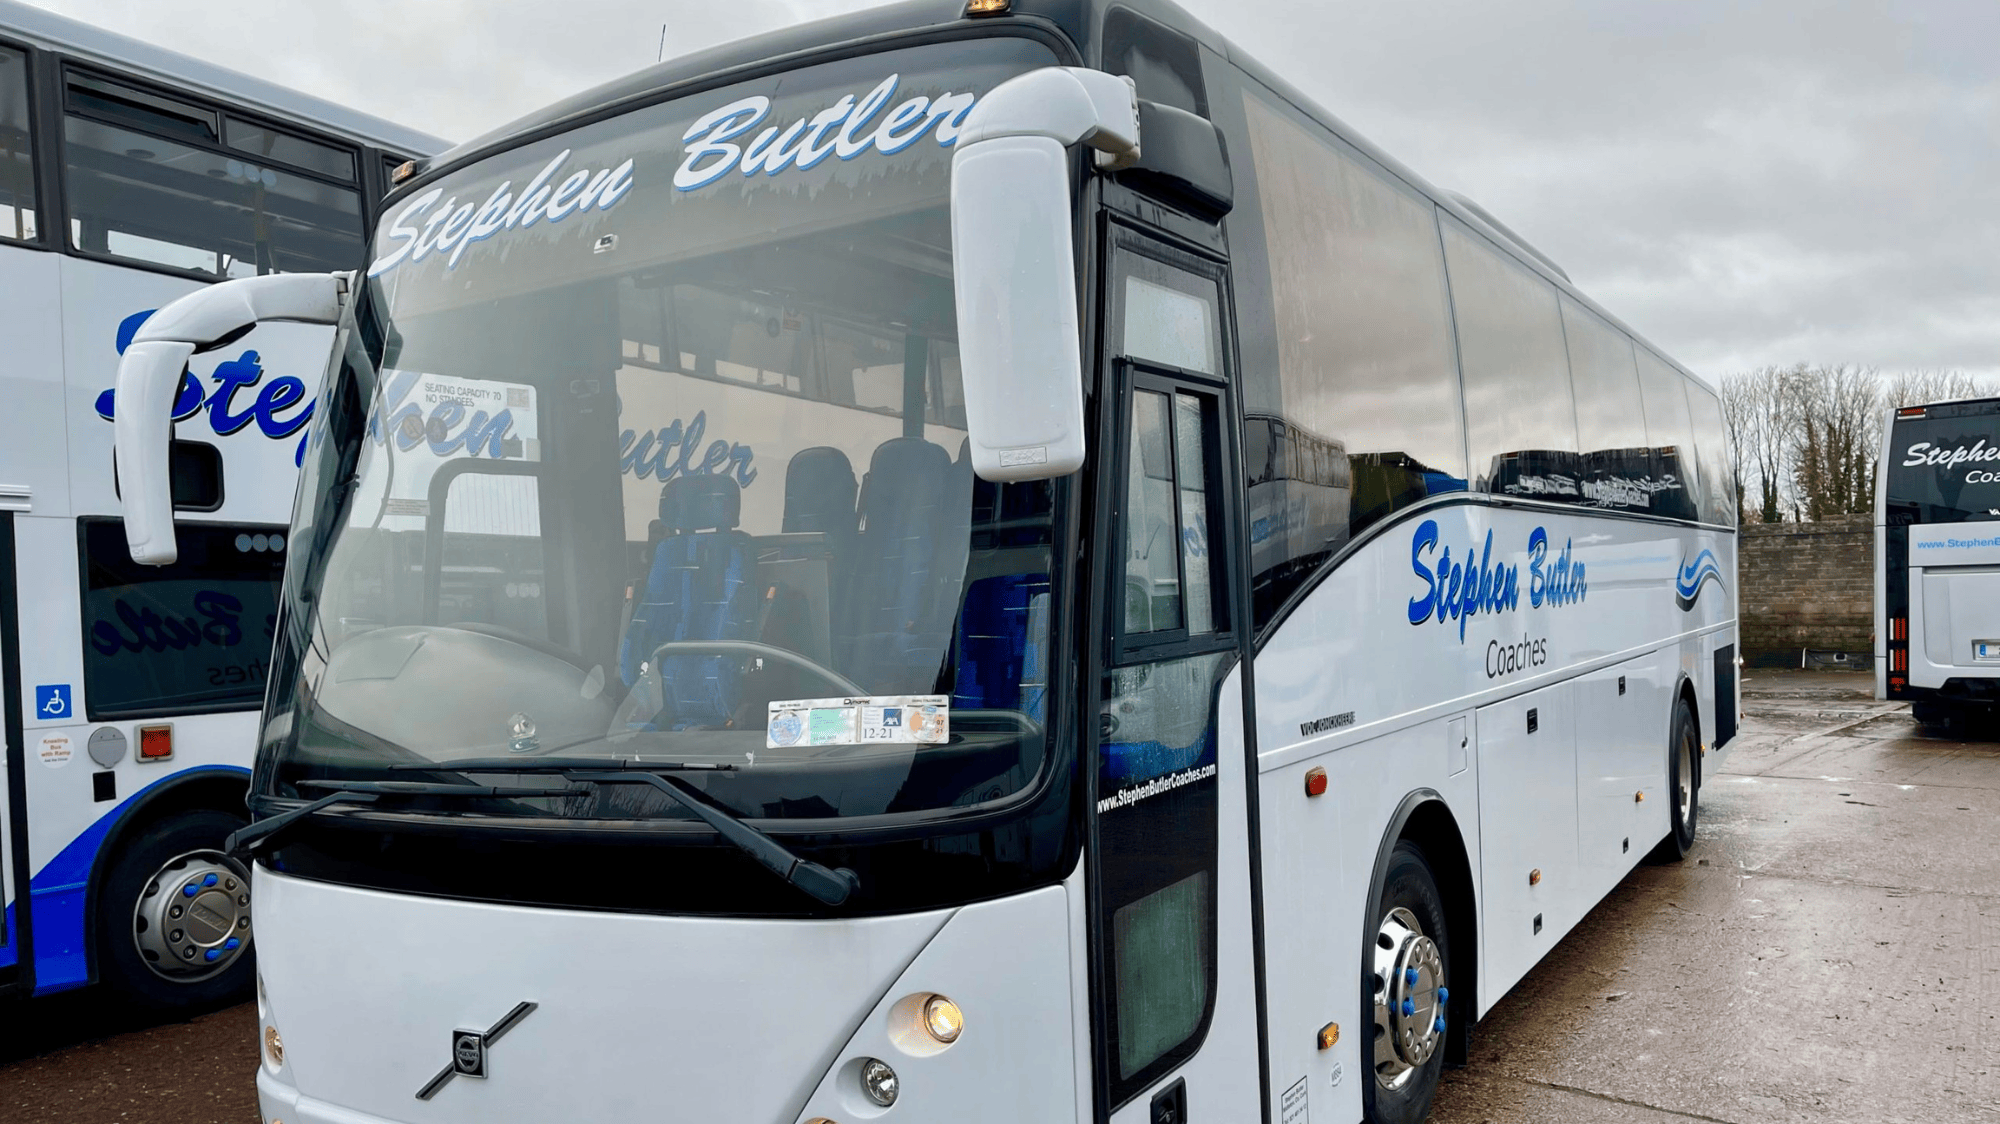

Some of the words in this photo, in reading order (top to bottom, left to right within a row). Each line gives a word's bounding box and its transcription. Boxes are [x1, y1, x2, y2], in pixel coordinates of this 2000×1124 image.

[367, 149, 634, 279] Stephen
[673, 73, 976, 191] Butler
[425, 382, 455, 396] SEATING
[457, 386, 491, 400] CAPACITY
[425, 394, 437, 404] NO
[1903, 439, 2000, 470] Stephe
[1408, 519, 1520, 645] Stephen
[1528, 526, 1587, 609] Butler
[1486, 632, 1548, 679] Coaches
[863, 728, 893, 739] 12-21
[1097, 763, 1216, 814] www.StephenButlerCoaches.com
